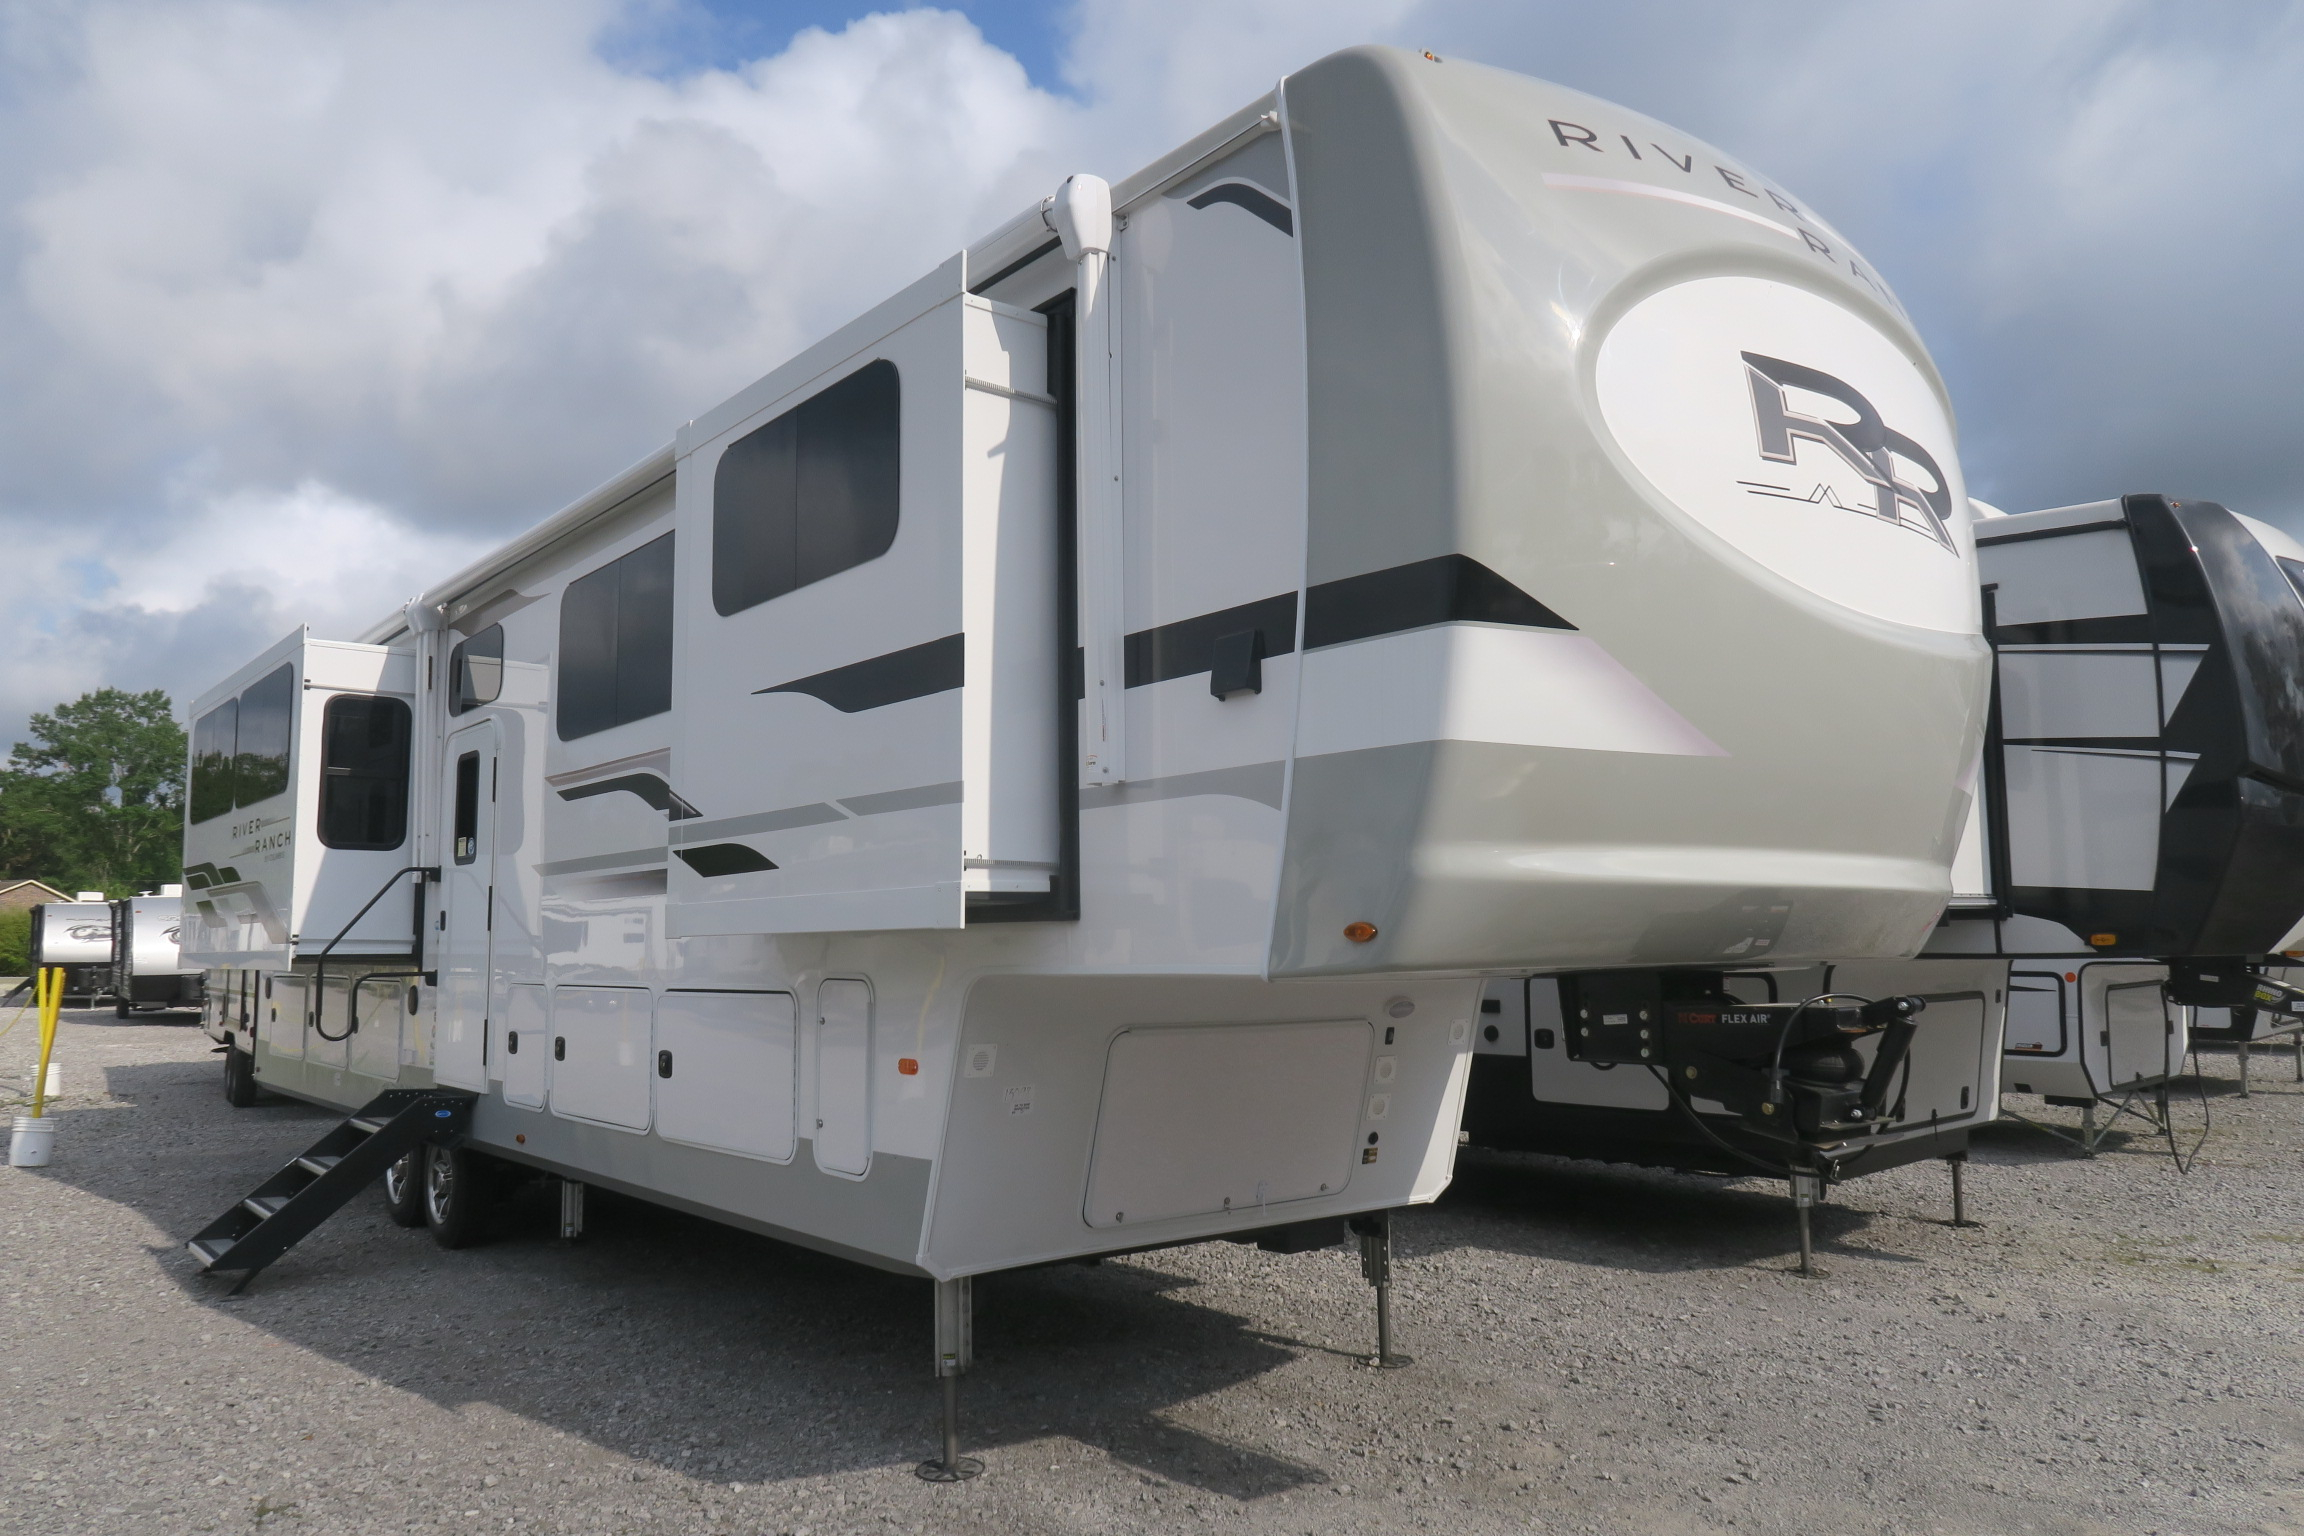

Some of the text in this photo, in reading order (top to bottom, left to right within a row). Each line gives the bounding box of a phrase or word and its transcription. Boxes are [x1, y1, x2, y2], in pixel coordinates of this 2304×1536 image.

[1547, 118, 1806, 222] RIVER
[232, 818, 261, 839] RIVER
[255, 831, 291, 853] RANCH
[2257, 984, 2283, 997] RHINO
[1721, 1013, 1748, 1024] FLEX
